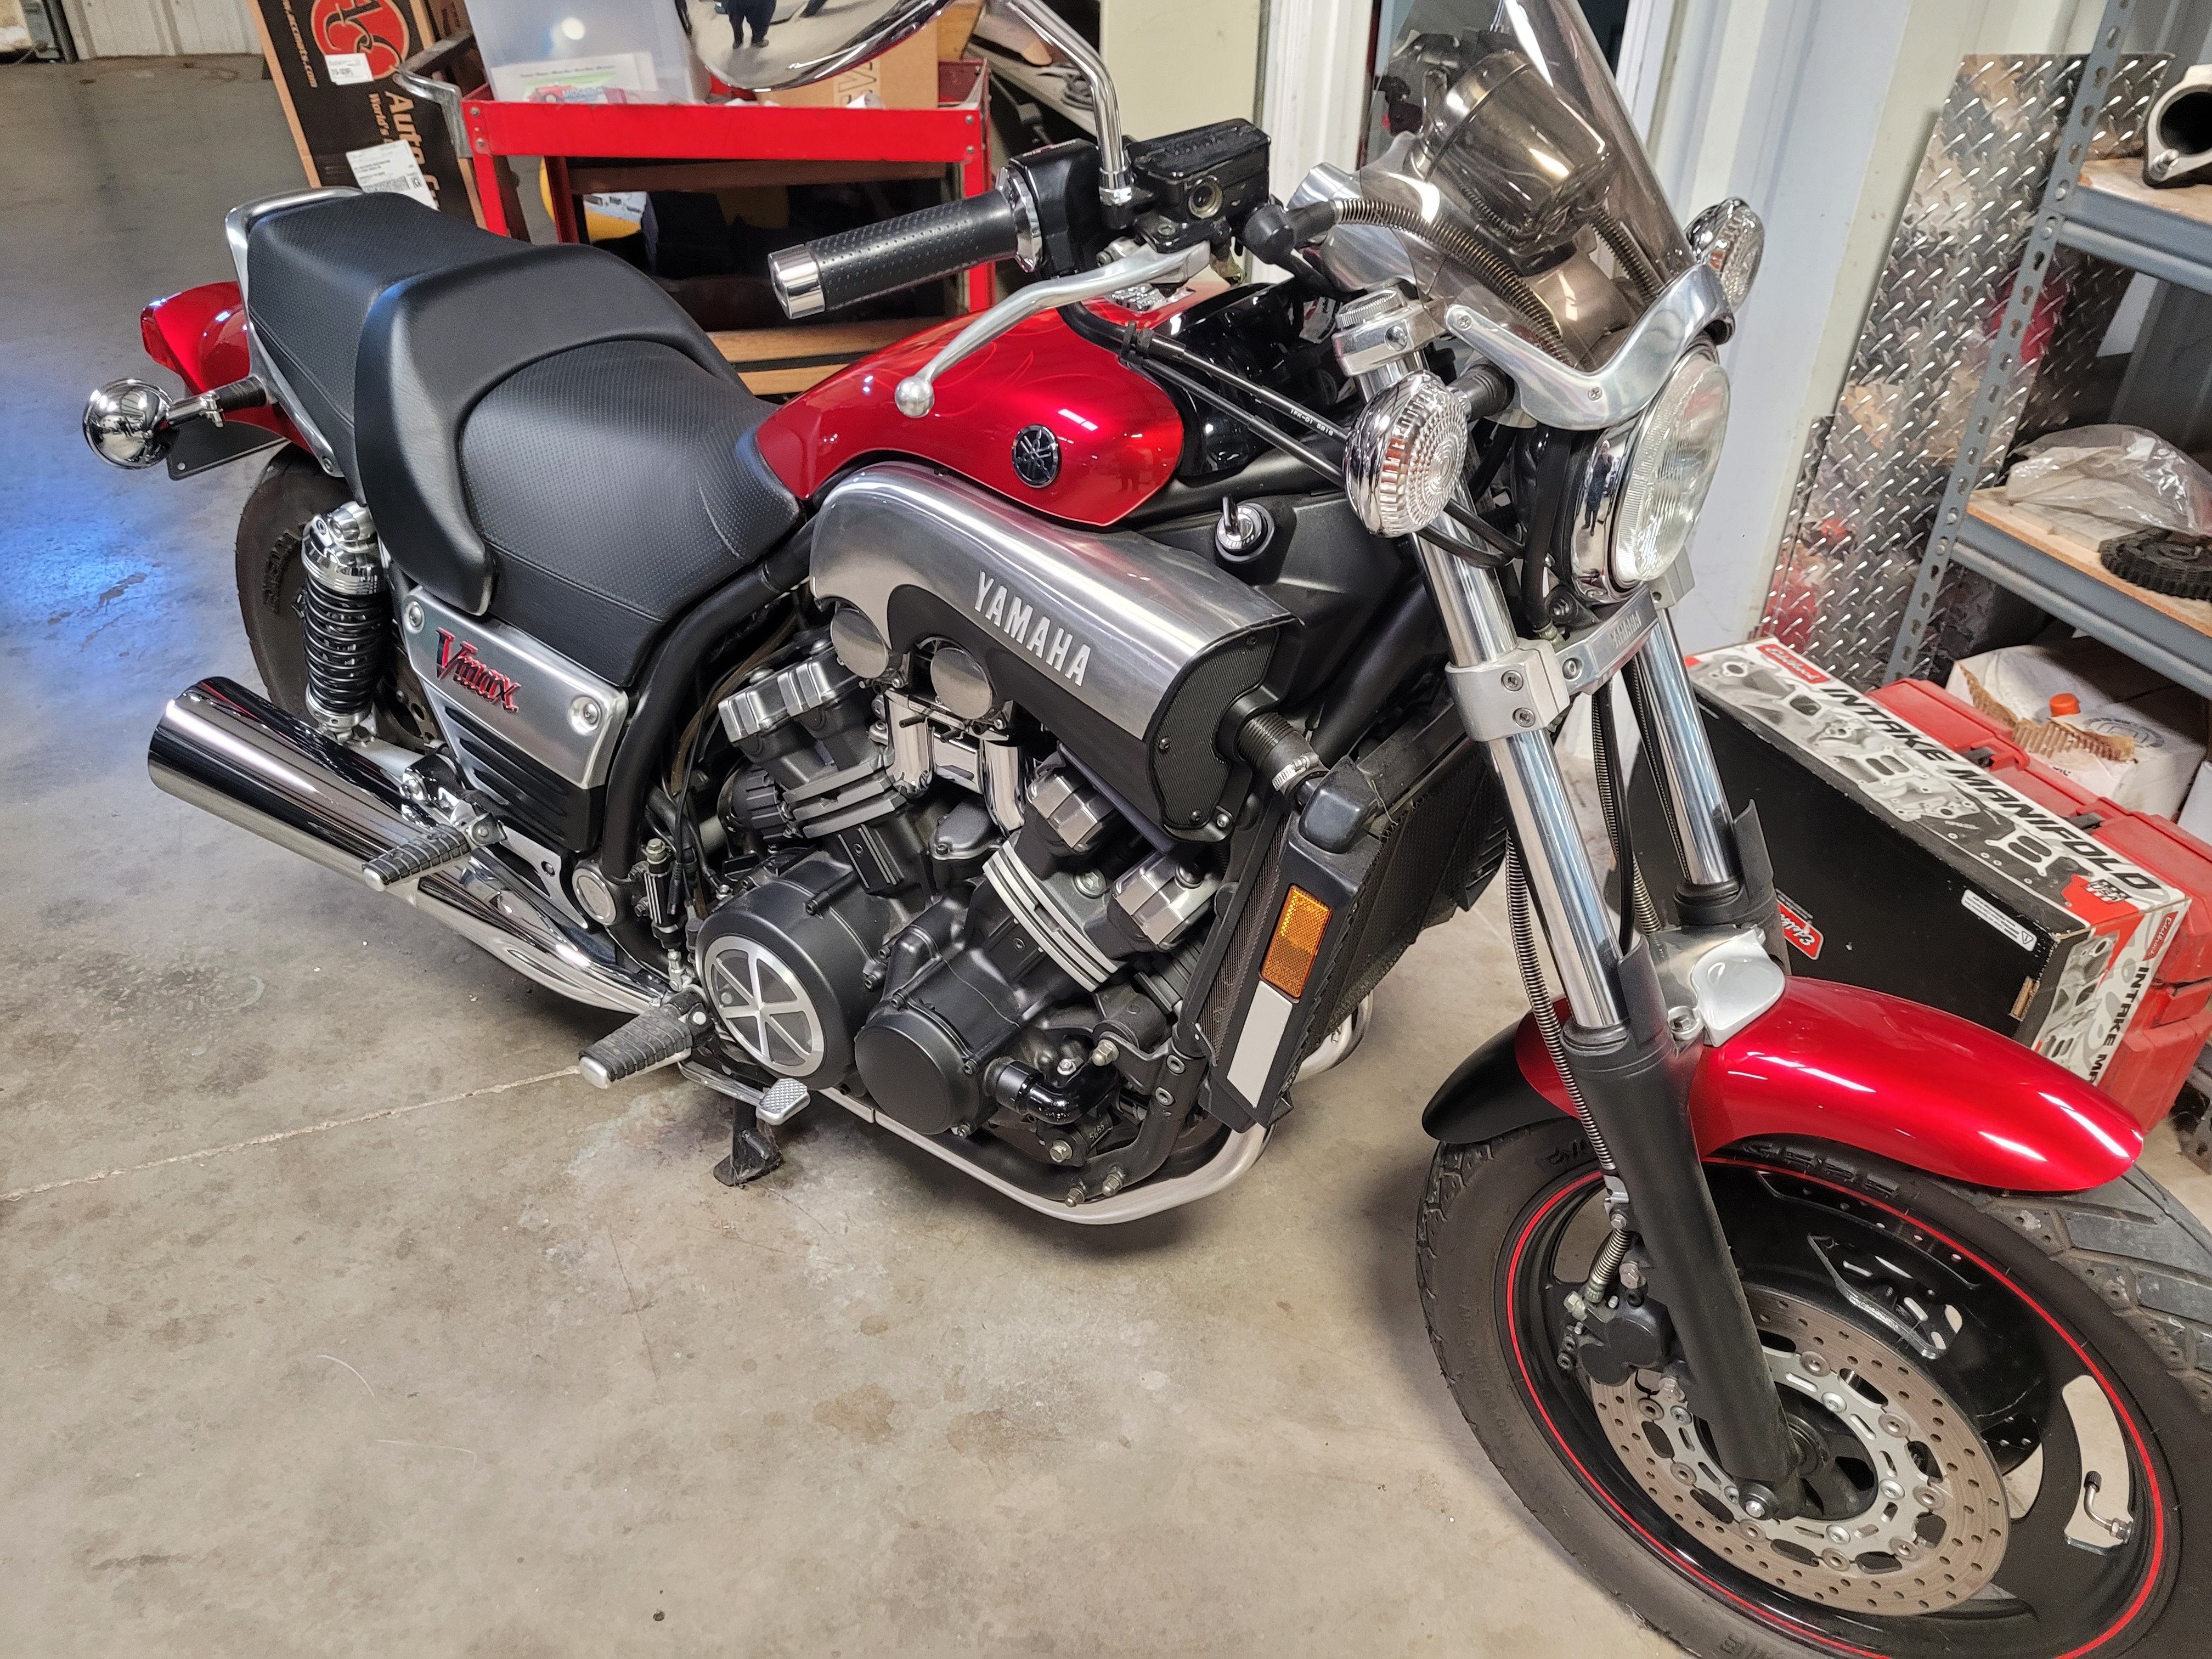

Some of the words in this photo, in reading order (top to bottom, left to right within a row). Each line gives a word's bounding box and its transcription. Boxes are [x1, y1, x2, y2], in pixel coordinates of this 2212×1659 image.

[369, 93, 390, 136] World's
[974, 570, 1092, 687] YAMAHA
[1610, 611, 1642, 648] YAMAHA
[1820, 688, 1956, 763] INTAKE
[1945, 769, 2163, 890] MANIFOLD
[2089, 882, 2118, 901] USA
[1780, 913, 1815, 946] Edelbr
[2102, 967, 2149, 1046] INTAKE
